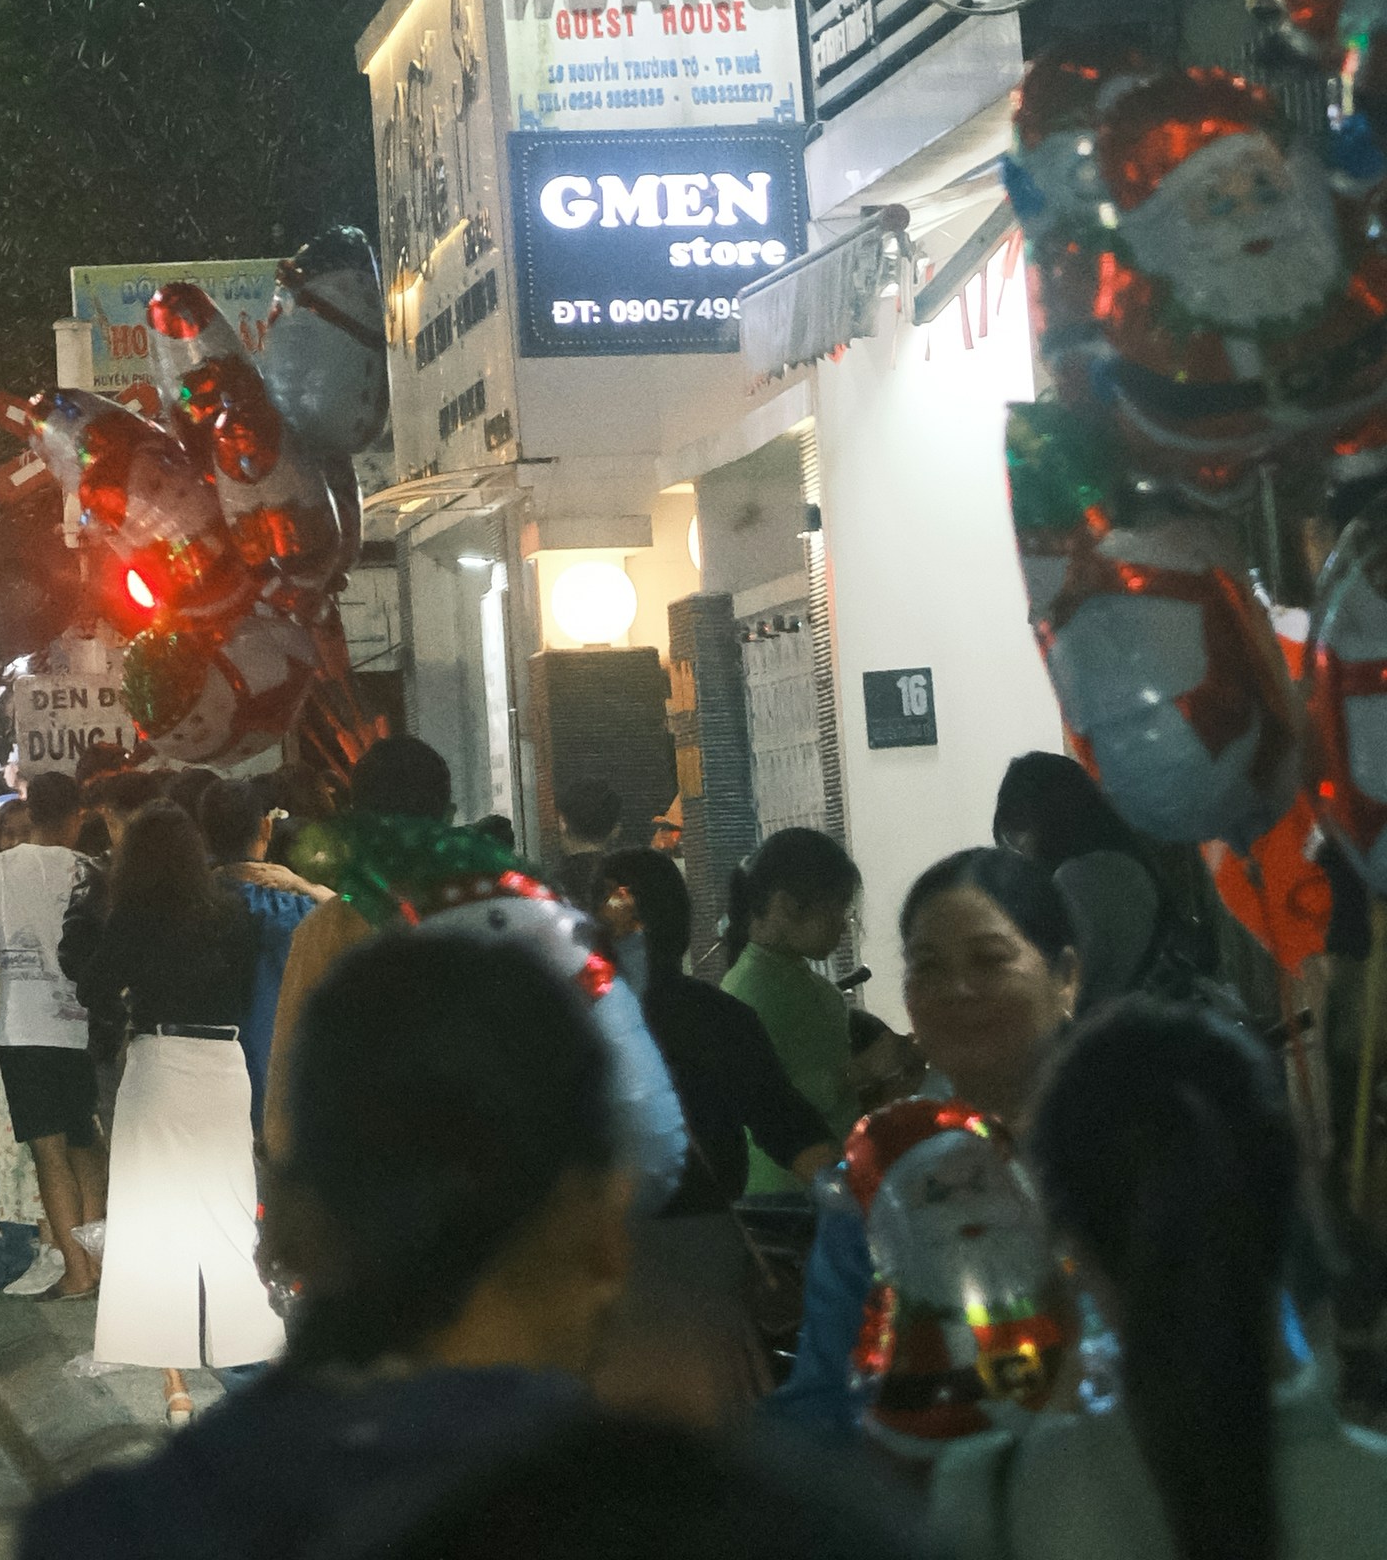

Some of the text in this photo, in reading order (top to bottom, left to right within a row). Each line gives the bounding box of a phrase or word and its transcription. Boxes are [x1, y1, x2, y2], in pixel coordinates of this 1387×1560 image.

[556, 1, 748, 40] GUEST HOUSE
[539, 172, 772, 229] GMEN
[668, 235, 787, 267] store
[551, 300, 602, 324] ĐT:
[896, 674, 929, 717] 16
